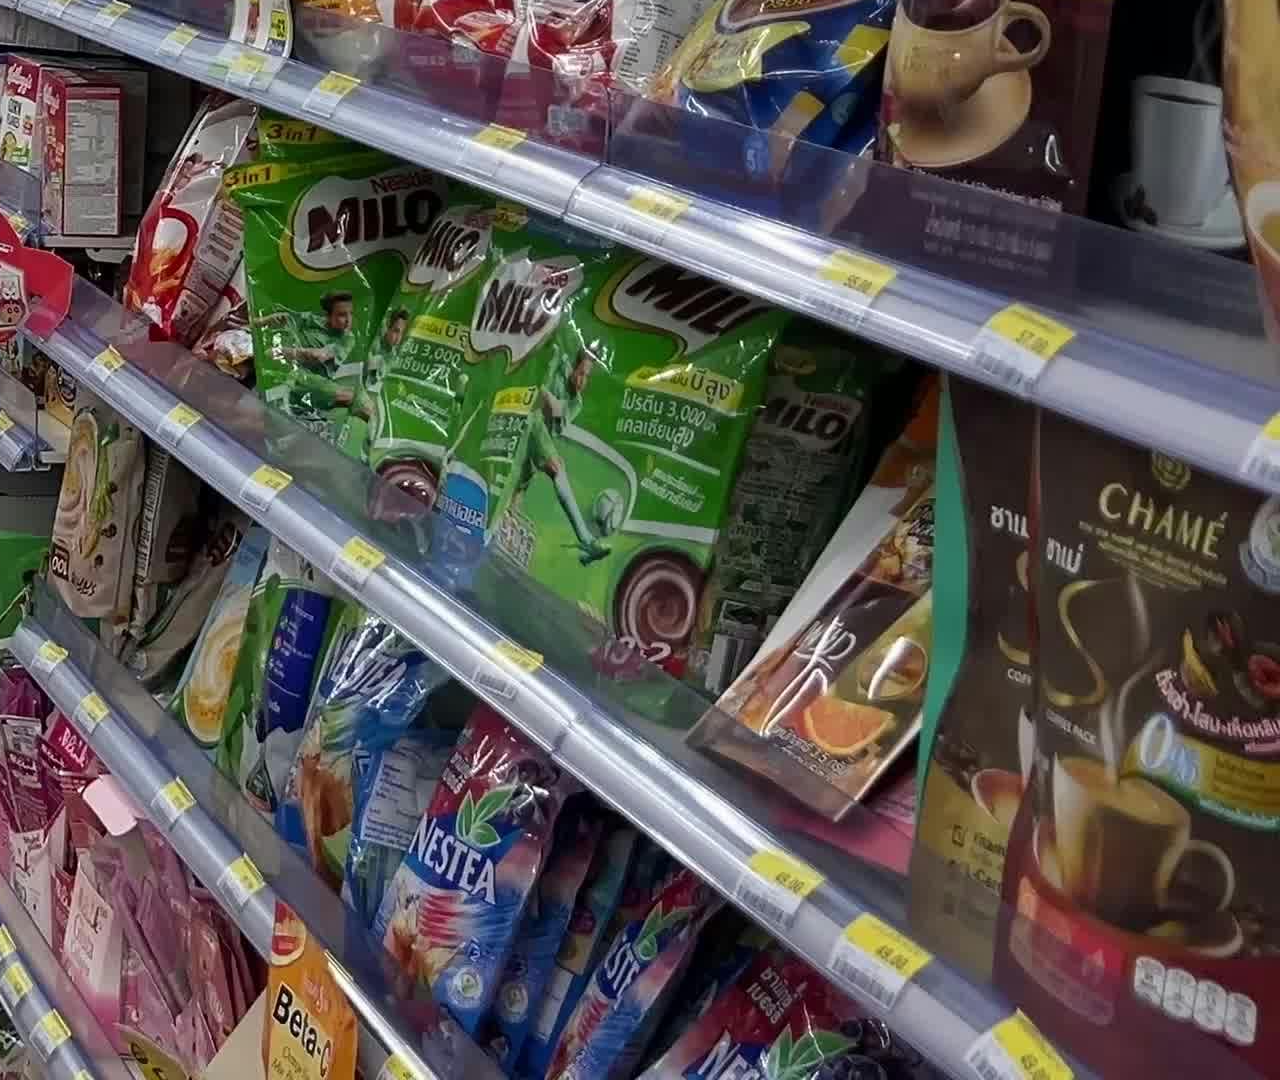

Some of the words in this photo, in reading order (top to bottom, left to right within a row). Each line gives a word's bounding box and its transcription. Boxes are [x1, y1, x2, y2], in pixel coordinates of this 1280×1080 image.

[306, 188, 443, 254] MILO
[1098, 480, 1230, 560] CHAMÉ
[408, 810, 496, 905] NESTEA
[272, 982, 332, 1078] Beta-C
